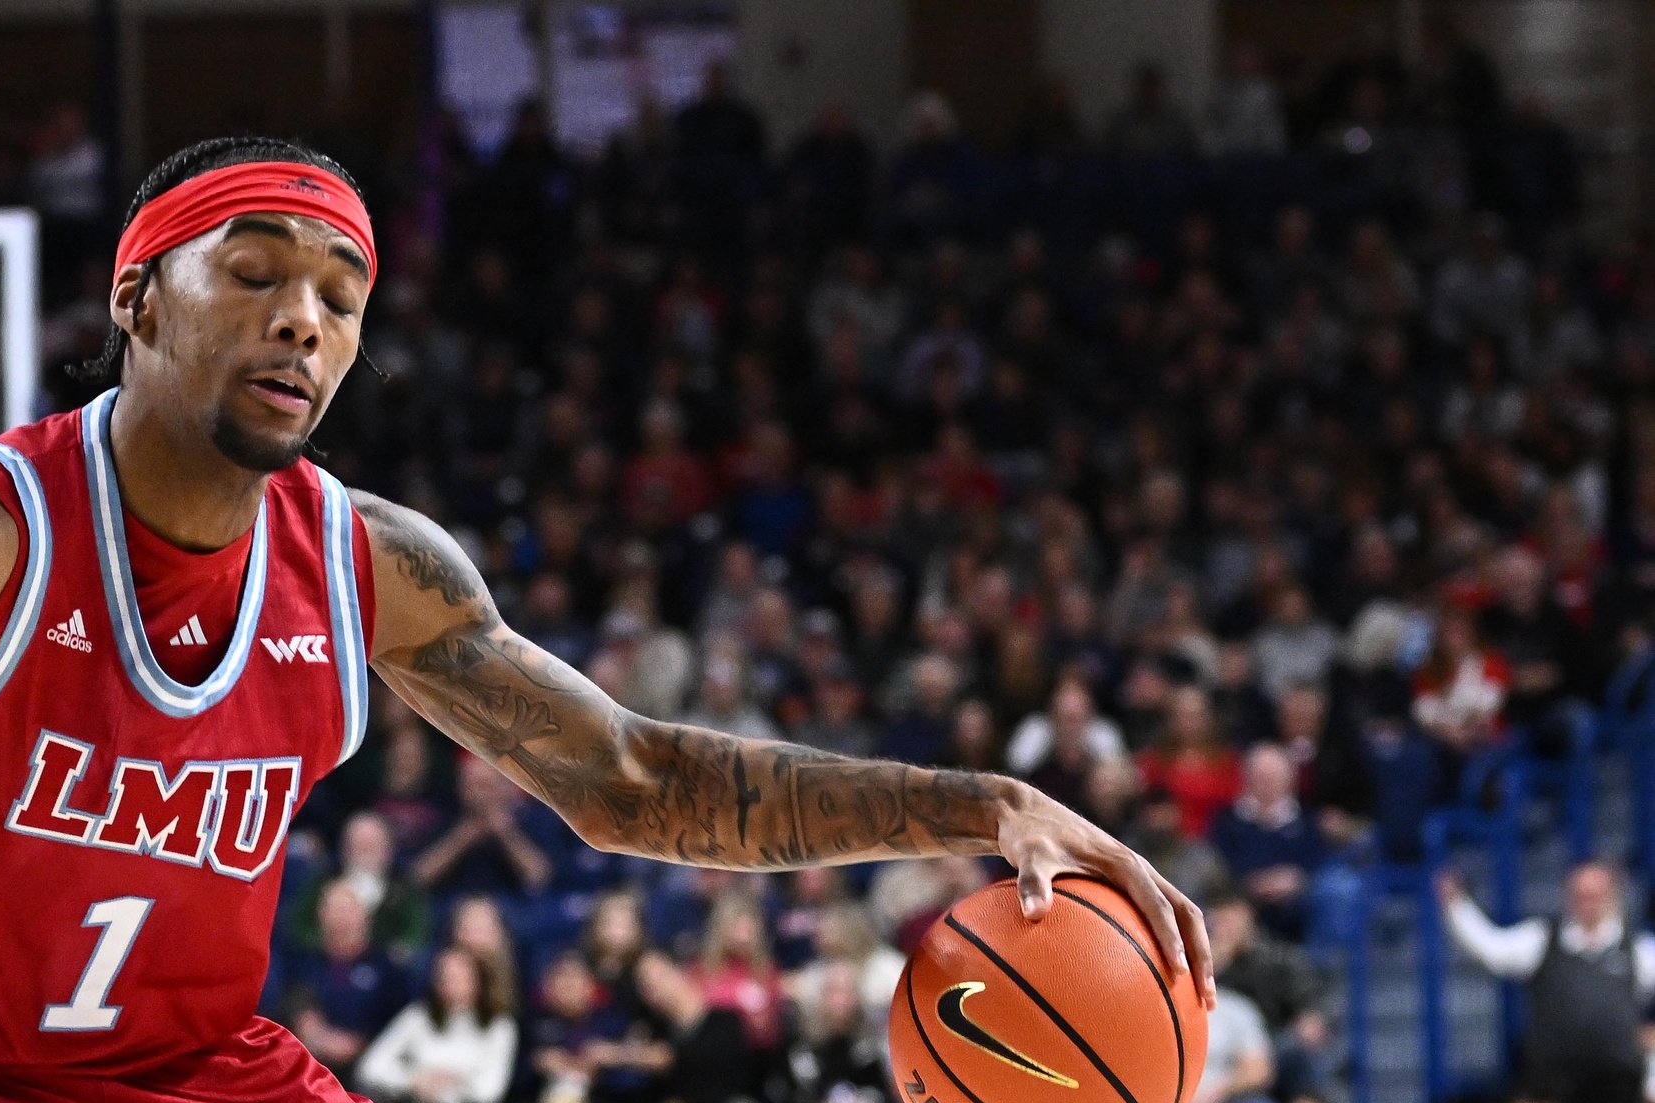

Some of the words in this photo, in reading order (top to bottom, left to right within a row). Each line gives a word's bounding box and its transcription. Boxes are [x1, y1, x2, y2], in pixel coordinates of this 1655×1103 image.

[46, 628, 93, 653] adidas
[259, 634, 330, 664] WCC
[5, 729, 301, 881] LMU
[39, 897, 155, 1033] 1
